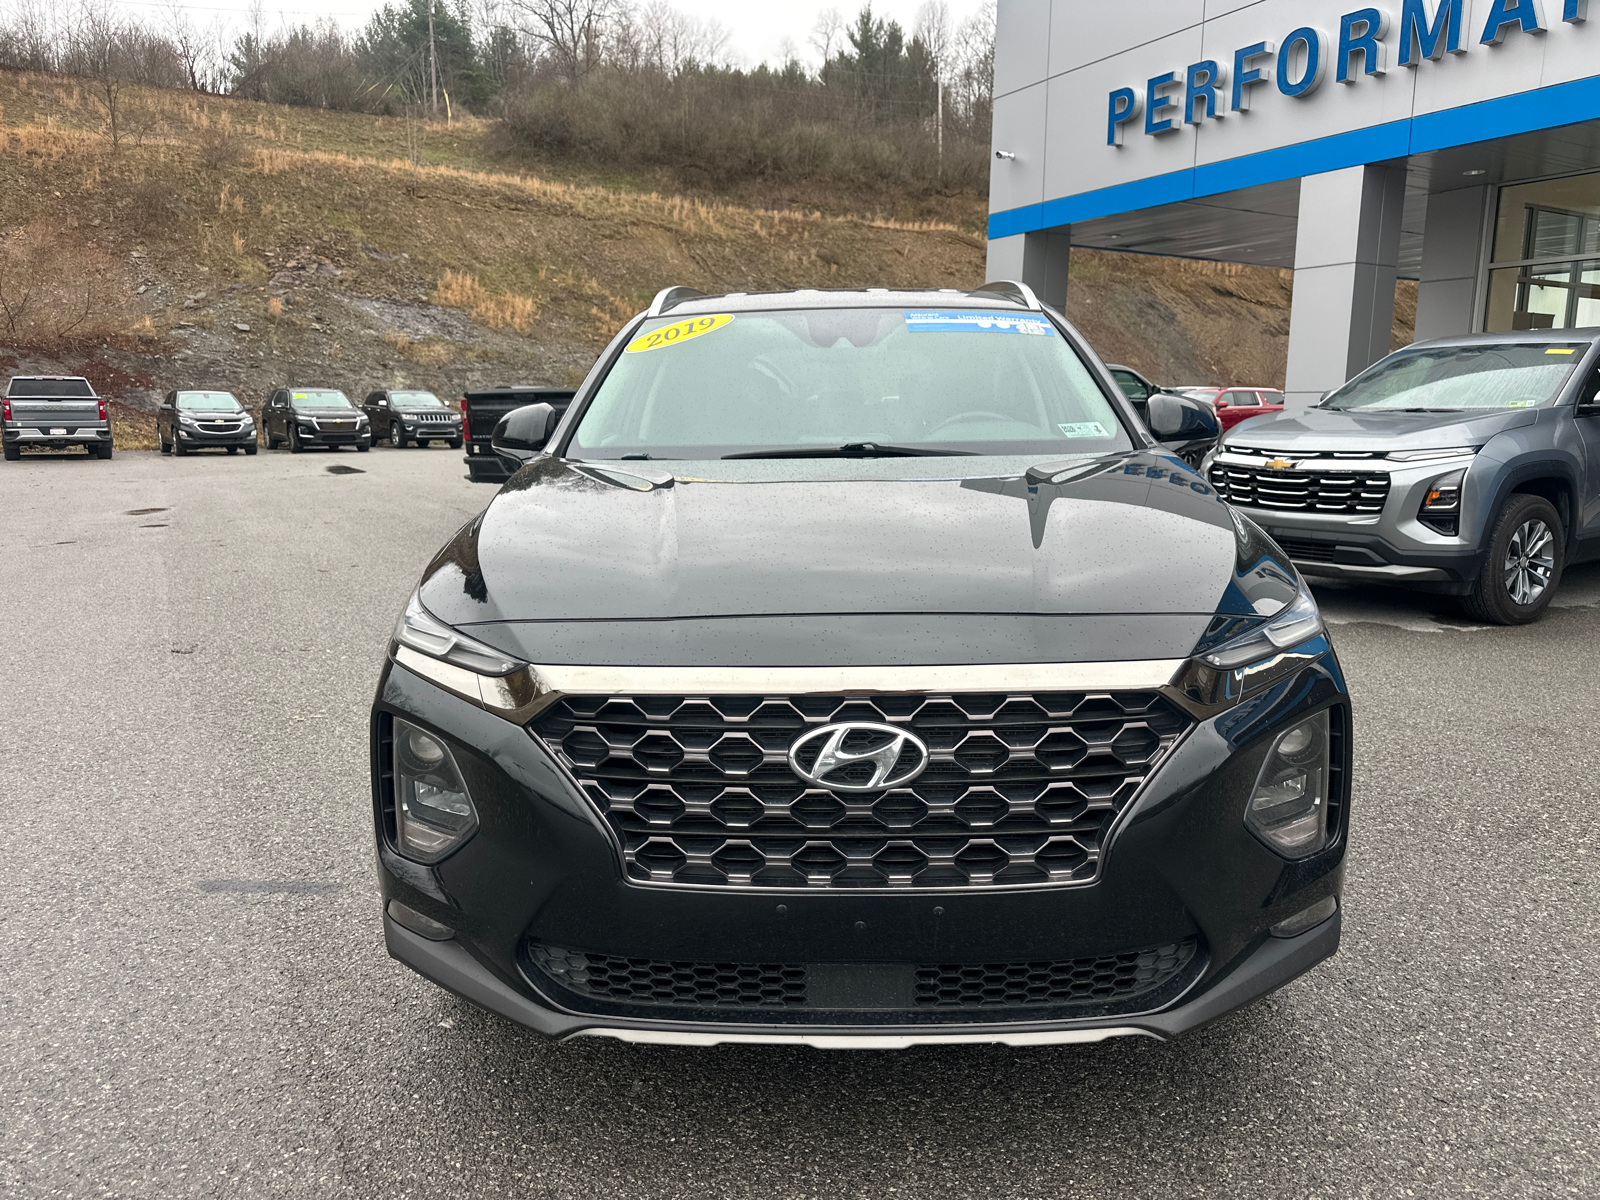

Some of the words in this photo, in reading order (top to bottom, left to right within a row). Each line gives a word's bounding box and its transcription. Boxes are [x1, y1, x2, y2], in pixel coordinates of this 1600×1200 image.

[1107, 0, 1588, 147] PERFORMA
[646, 317, 716, 349] 2019
[995, 315, 1041, 324] Warranty
